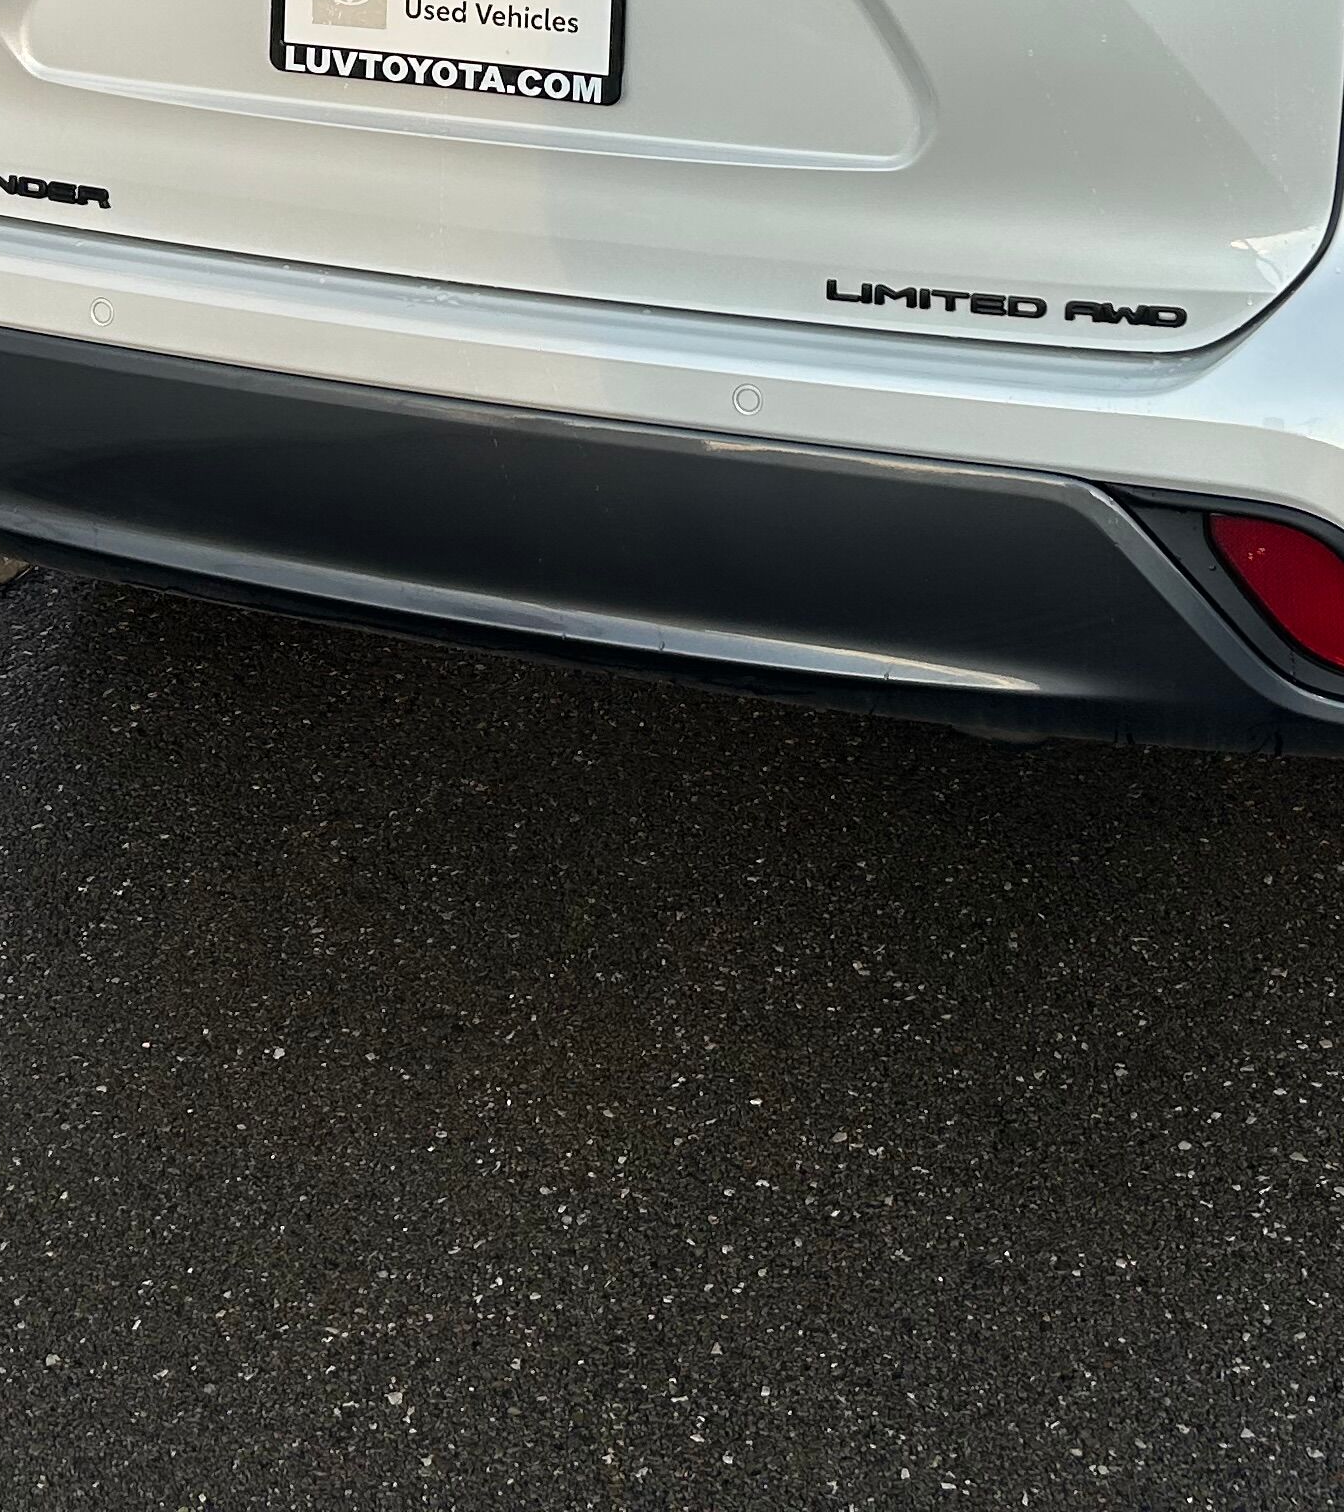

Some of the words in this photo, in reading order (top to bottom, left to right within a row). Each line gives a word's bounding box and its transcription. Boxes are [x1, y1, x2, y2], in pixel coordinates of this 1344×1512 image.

[475, 2, 579, 34] Vehicles
[284, 45, 603, 104] LUVTOYOTA.COM
[825, 278, 1048, 319] LIMITED
[1064, 299, 1188, 329] AWD
